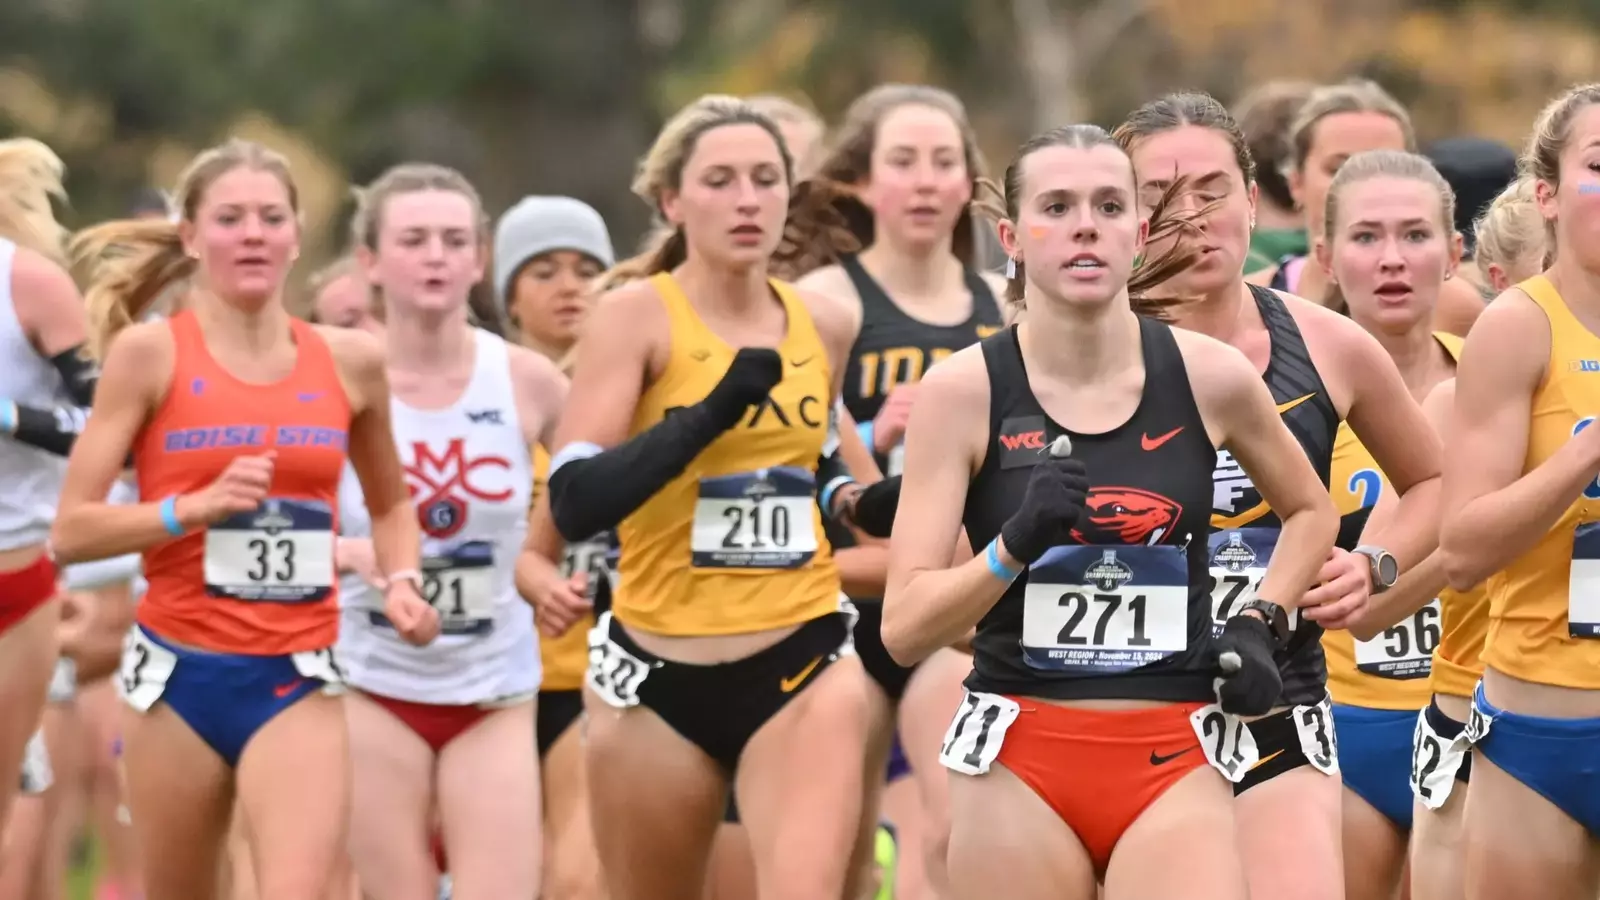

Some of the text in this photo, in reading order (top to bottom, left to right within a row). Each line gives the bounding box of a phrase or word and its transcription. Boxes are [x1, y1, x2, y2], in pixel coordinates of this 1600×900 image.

[859, 346, 954, 399] ID
[165, 425, 348, 452] BOISE STAT
[1000, 430, 1046, 451] WCC
[722, 506, 789, 548] 210
[248, 539, 295, 581] 33
[1057, 592, 1151, 646] 271
[1385, 607, 1440, 657] 56
[1048, 650, 1068, 658] WEST
[1068, 650, 1095, 659] REGION
[1099, 651, 1131, 660] November
[1144, 652, 1163, 661] 2024
